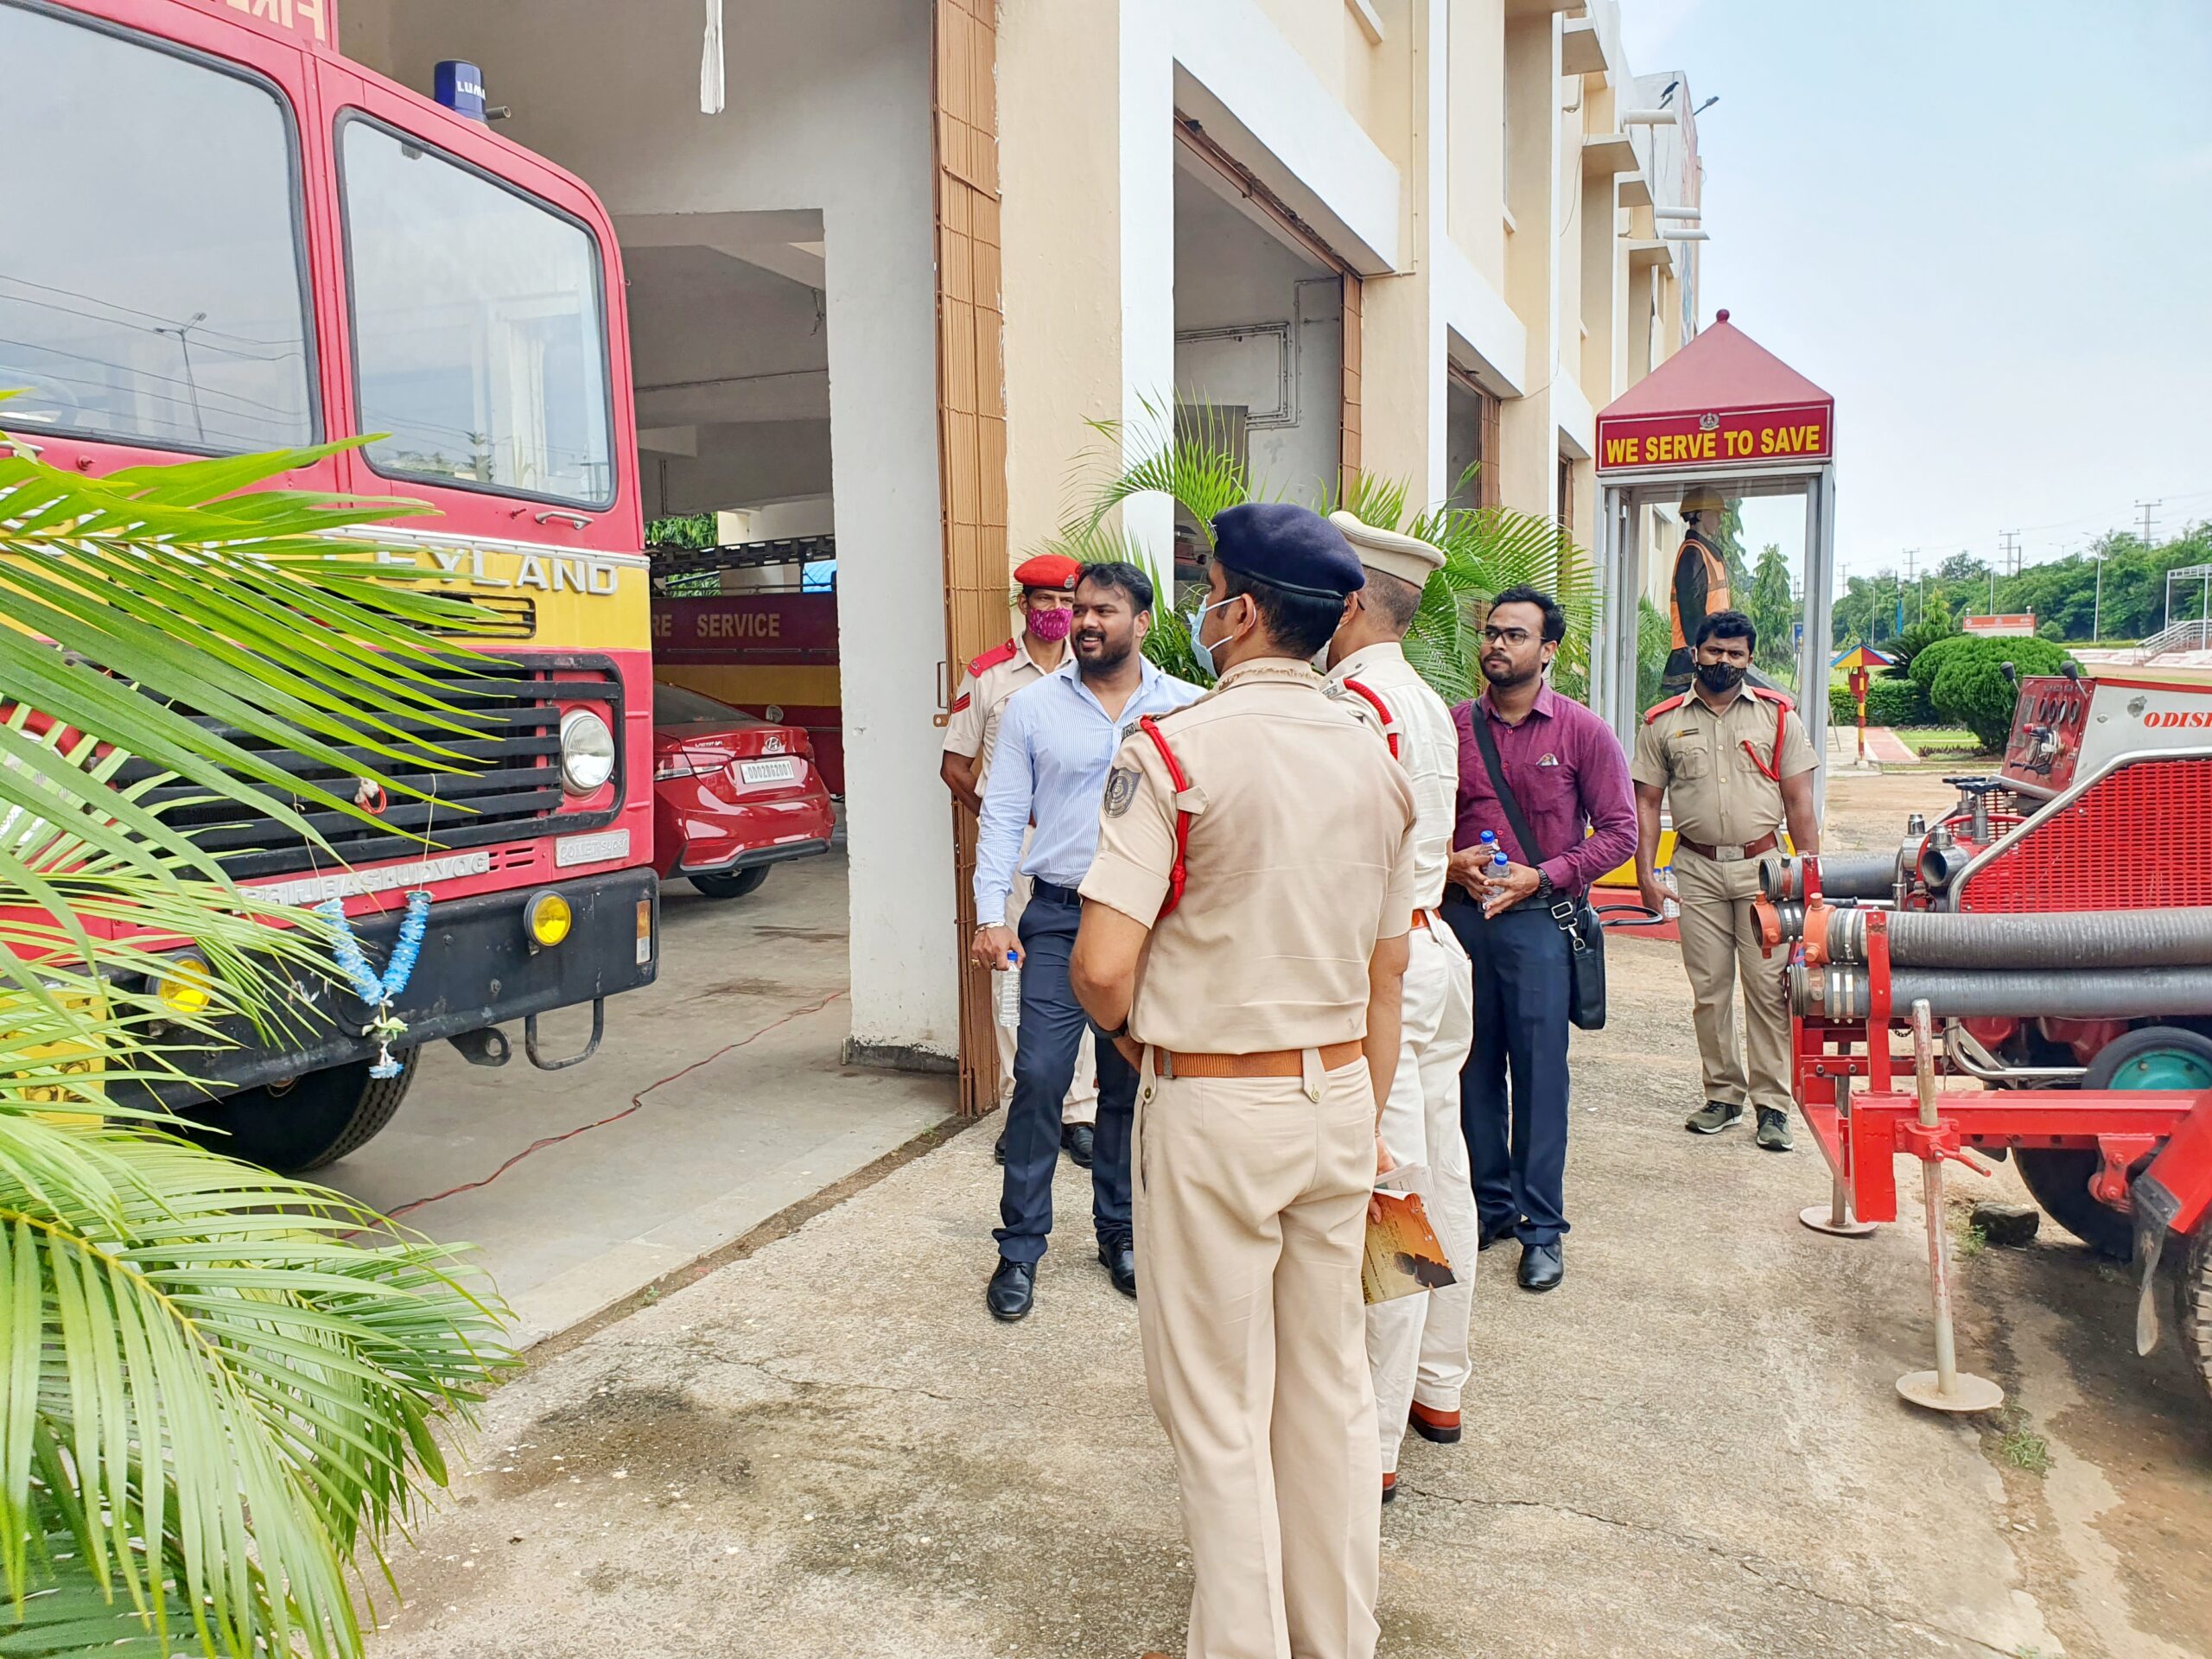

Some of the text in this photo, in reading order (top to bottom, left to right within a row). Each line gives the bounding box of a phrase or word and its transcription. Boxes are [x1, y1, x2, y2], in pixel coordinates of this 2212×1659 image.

[1606, 425, 1820, 463] WE SERVE TO SAVE
[696, 613, 780, 637] SERVICE
